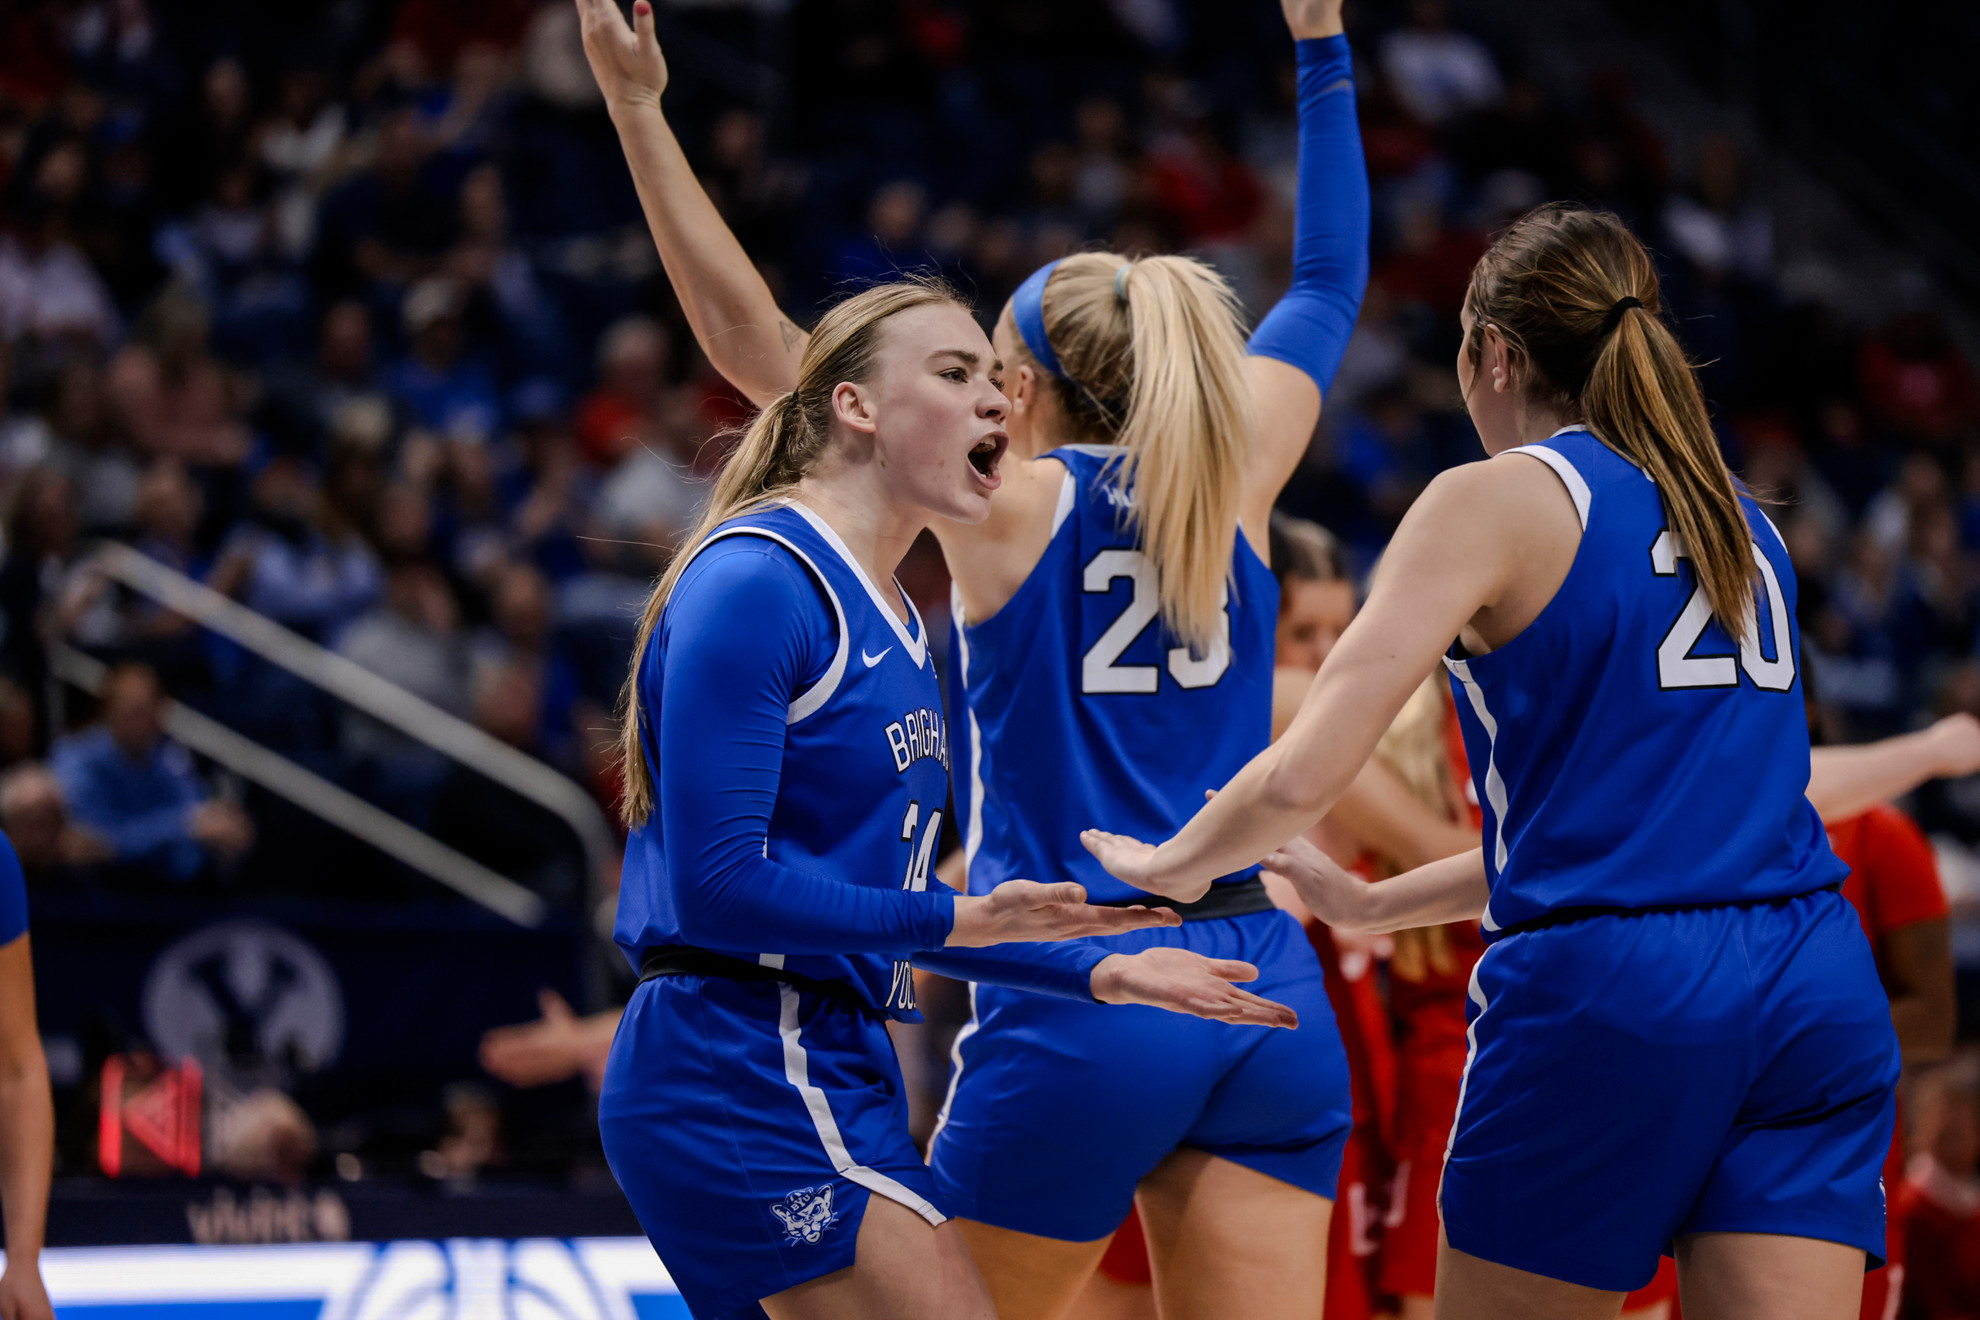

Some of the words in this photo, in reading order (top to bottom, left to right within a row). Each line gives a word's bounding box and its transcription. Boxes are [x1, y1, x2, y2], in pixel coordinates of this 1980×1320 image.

[1080, 547, 1231, 694] 23
[1650, 527, 1797, 693] 20
[884, 707, 949, 773] BRIGHA
[884, 959, 916, 1011] YOU
[790, 1193, 811, 1212] BYU
